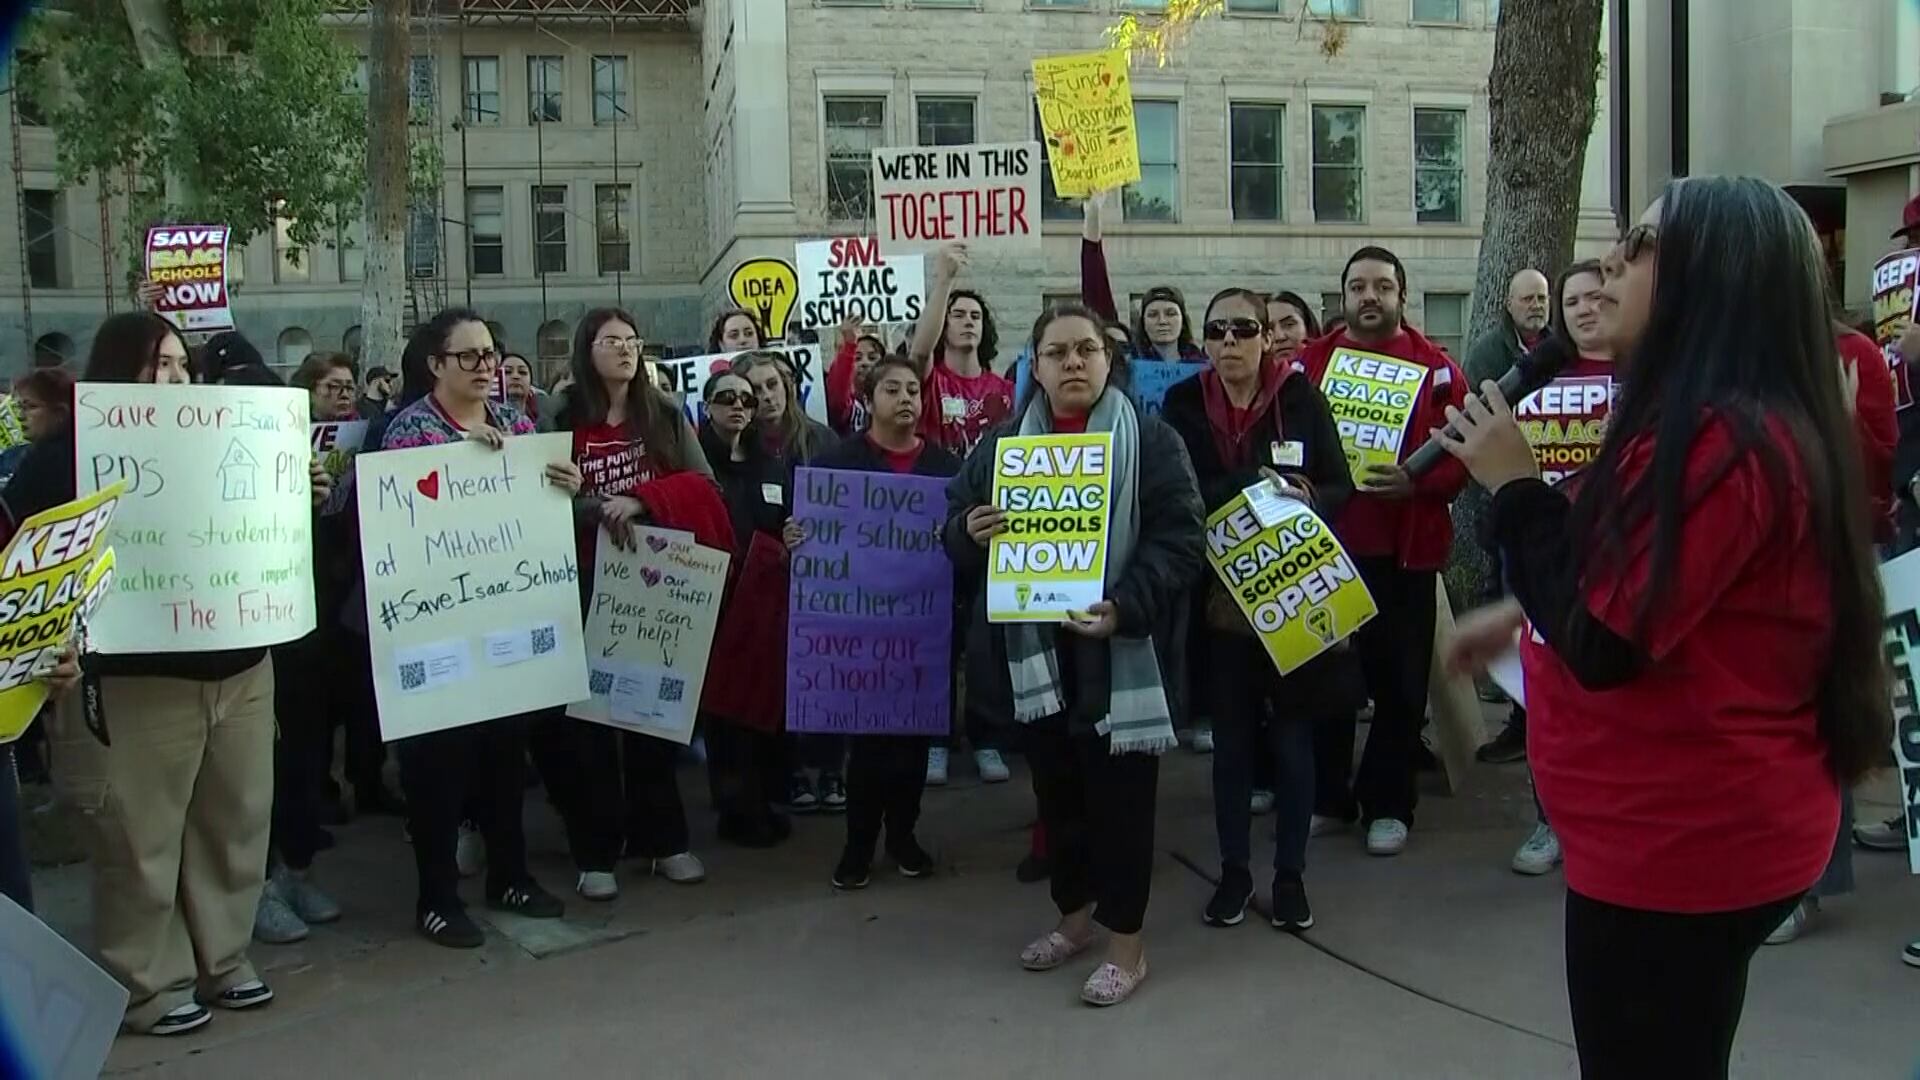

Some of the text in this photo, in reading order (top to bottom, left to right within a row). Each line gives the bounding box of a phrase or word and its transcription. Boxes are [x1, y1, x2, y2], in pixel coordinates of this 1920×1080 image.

[1047, 61, 1102, 98] Fund
[946, 152, 971, 178] IN
[978, 149, 1030, 176] THIS
[881, 187, 1030, 241] TOGETHER
[152, 230, 225, 247] SAVE
[151, 265, 222, 282] SCHOOLS
[743, 277, 786, 299] IDEA
[818, 267, 898, 298] ISAAC
[1872, 255, 1917, 298] KEEP
[160, 282, 221, 307] NOW
[804, 295, 920, 327] SCHOOLS
[1333, 353, 1423, 386] KEEP
[1325, 377, 1411, 410] ISAAC
[1518, 384, 1607, 416] KEEP
[79, 391, 158, 429] Save
[177, 404, 233, 431] our
[1331, 402, 1405, 425] CHOOLS
[1337, 418, 1402, 454] PEN
[582, 458, 605, 475] THE
[1000, 444, 1106, 478] SAVE
[1533, 446, 1601, 464] CHOOL
[92, 452, 165, 498] PDS
[378, 474, 417, 528] My
[444, 455, 516, 502] heart
[594, 470, 606, 485] IS
[608, 467, 621, 481] IN
[805, 469, 925, 516] We love
[999, 484, 1105, 512] ISAAC
[3, 498, 118, 580] KEEP
[112, 527, 168, 547] saac
[188, 511, 289, 549] students
[1001, 515, 1102, 535] SCHOOLS
[1206, 503, 1263, 560] KE
[375, 543, 398, 577] at
[792, 550, 849, 581] and
[996, 539, 1100, 575] NOW
[1222, 512, 1321, 589] ISAAC
[209, 571, 241, 588] are
[604, 561, 630, 580] We
[1242, 536, 1335, 604] SCHOOLS
[1252, 551, 1357, 633] OPEN
[161, 589, 297, 634] The Future
[596, 593, 694, 631] Please scan
[609, 619, 681, 649] to help!
[794, 627, 922, 662] Save our
